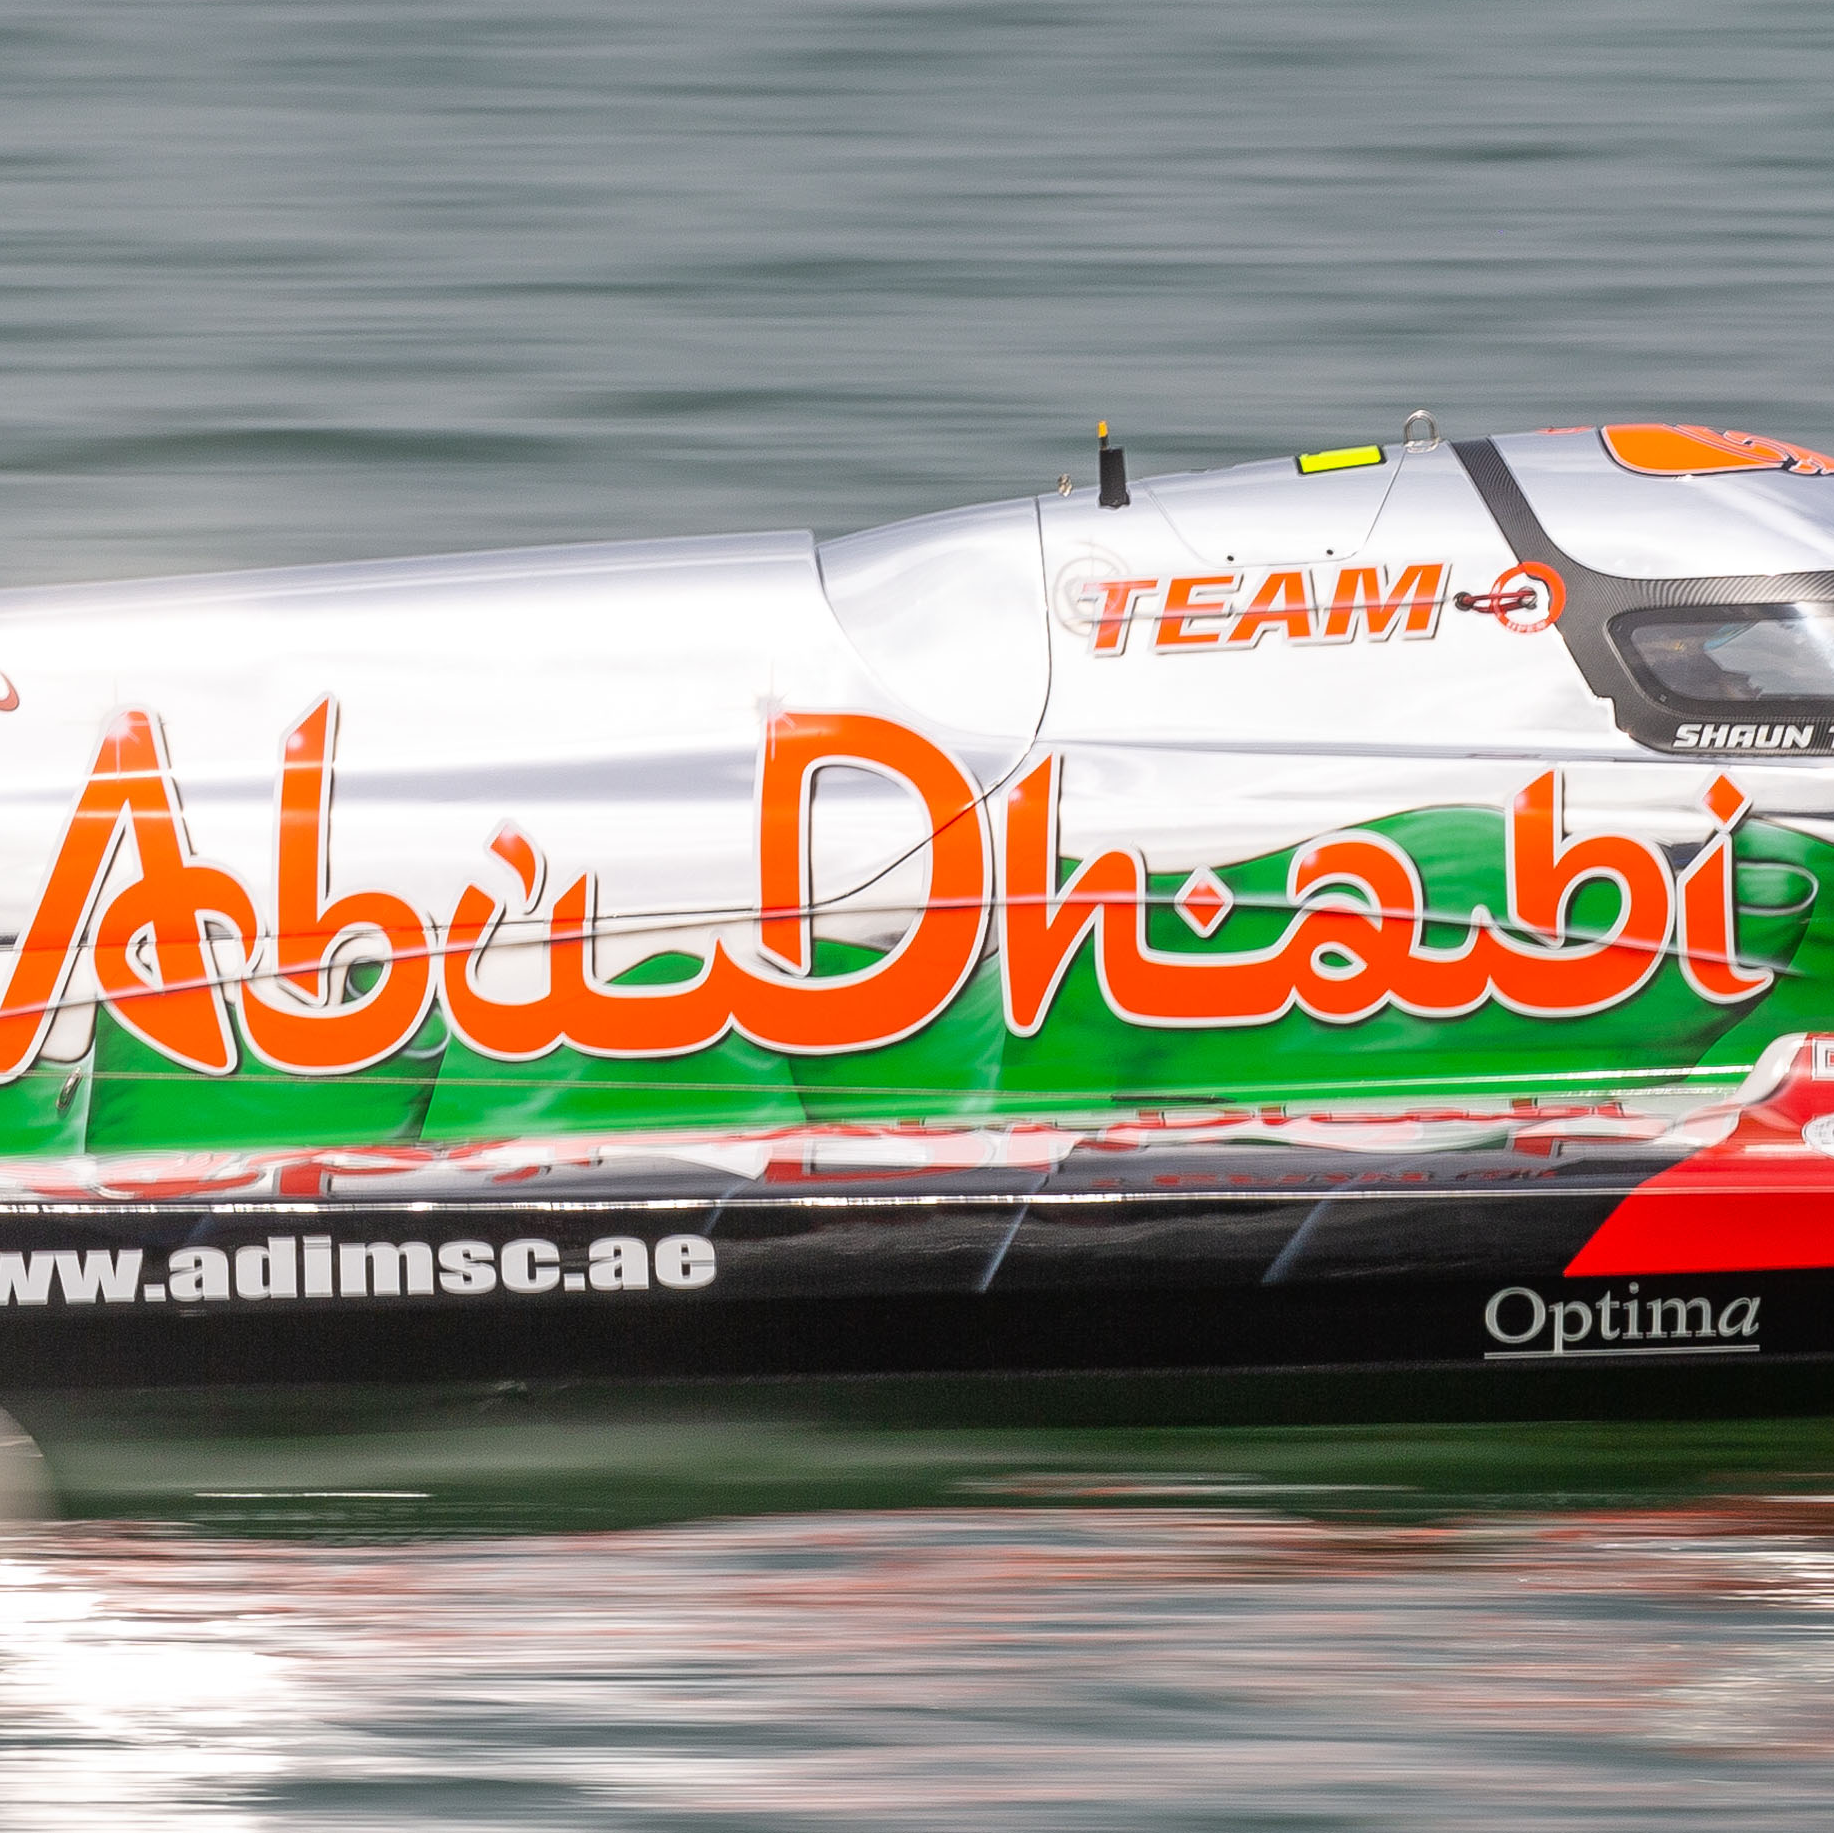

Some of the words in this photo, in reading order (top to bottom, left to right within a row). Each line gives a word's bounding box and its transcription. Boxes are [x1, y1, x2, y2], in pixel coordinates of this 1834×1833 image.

[1081, 561, 1452, 657] TEAM
[1673, 723, 1815, 749] SHAUN
[717, 707, 1775, 1056] Dhabi
[1484, 1280, 1761, 1355] Optima
